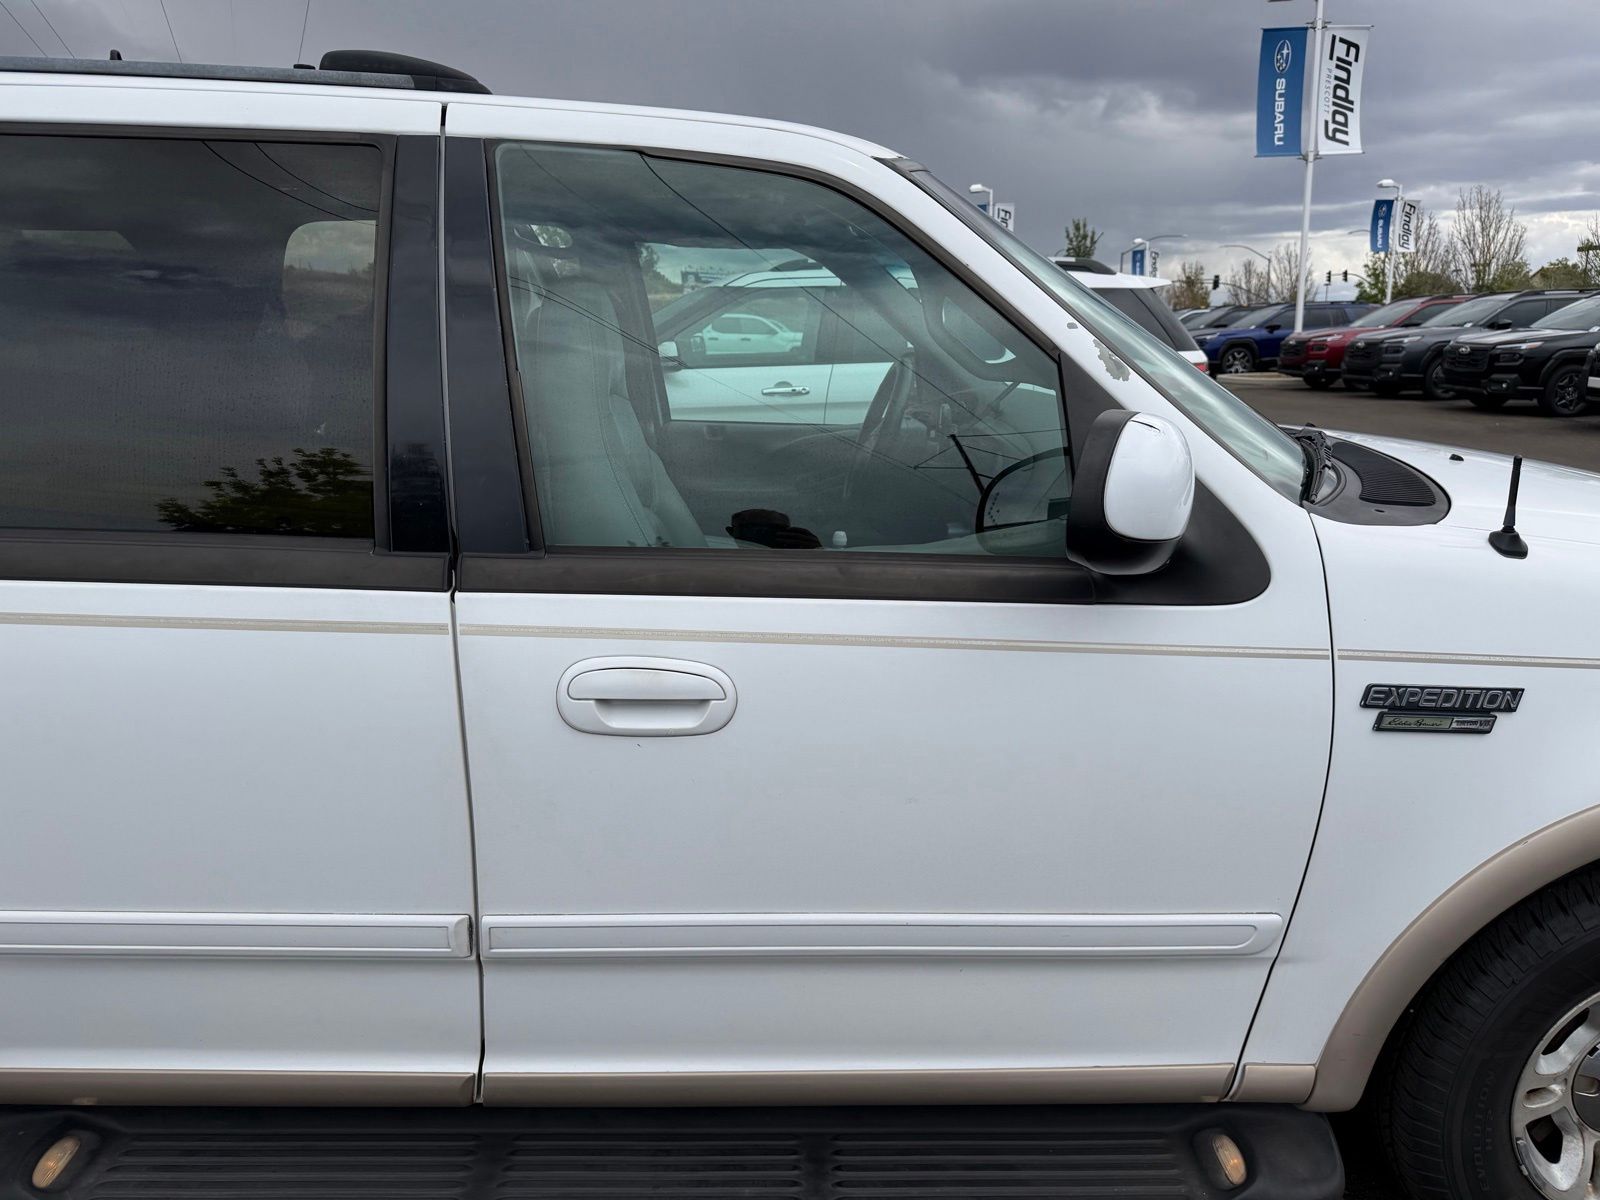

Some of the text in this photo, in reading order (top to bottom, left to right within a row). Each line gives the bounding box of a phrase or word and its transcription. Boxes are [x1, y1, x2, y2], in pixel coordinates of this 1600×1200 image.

[1274, 78, 1286, 146] SUBARU
[1324, 34, 1360, 146] Findlay
[1398, 201, 1417, 250] Findlay
[1366, 686, 1523, 710] EXPEDITION
